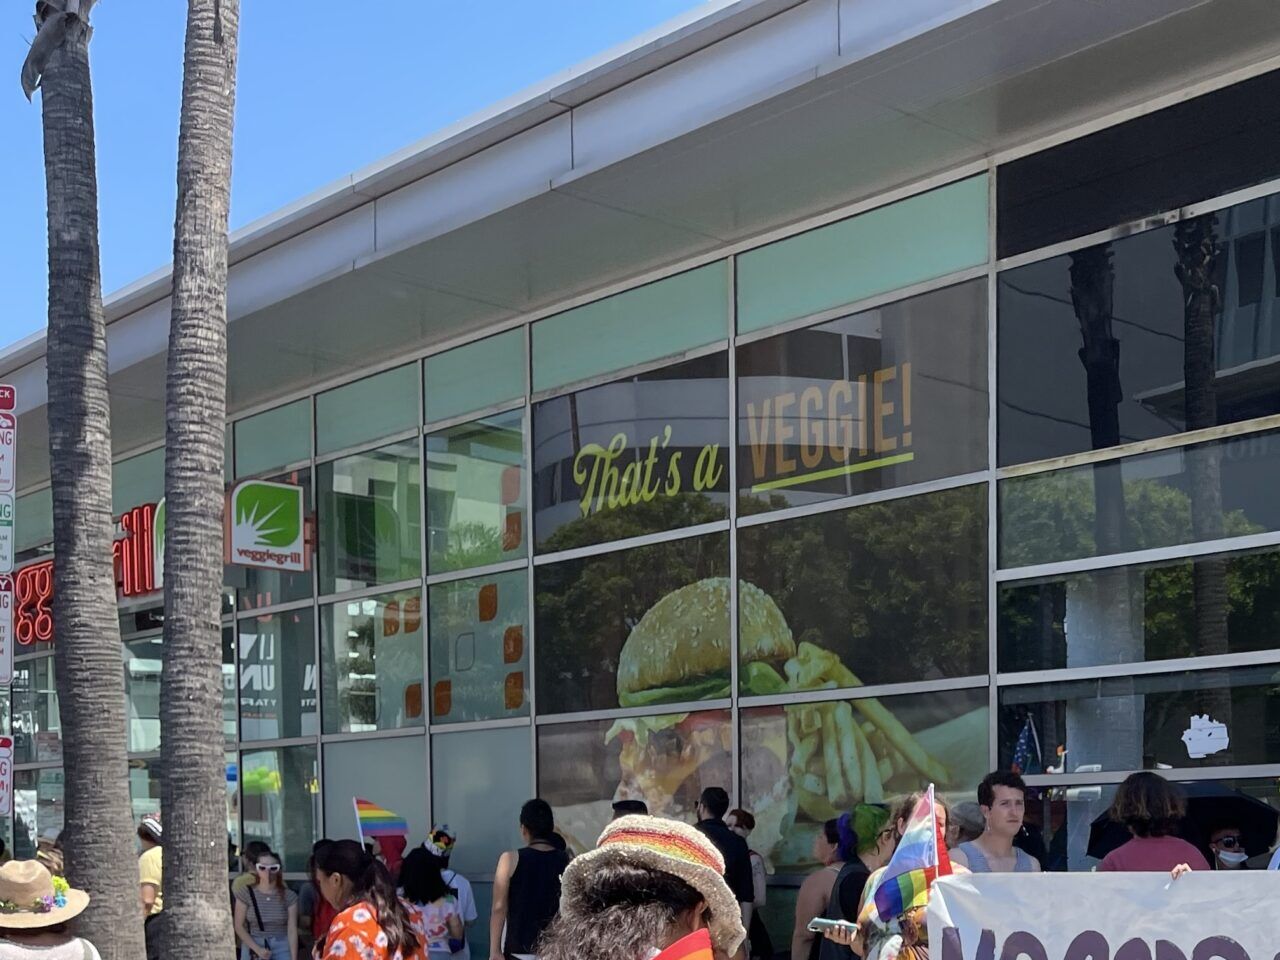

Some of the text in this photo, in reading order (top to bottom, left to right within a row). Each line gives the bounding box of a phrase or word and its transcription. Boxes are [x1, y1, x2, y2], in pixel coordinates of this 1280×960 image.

[573, 362, 913, 518] That's a VEGGIE!
